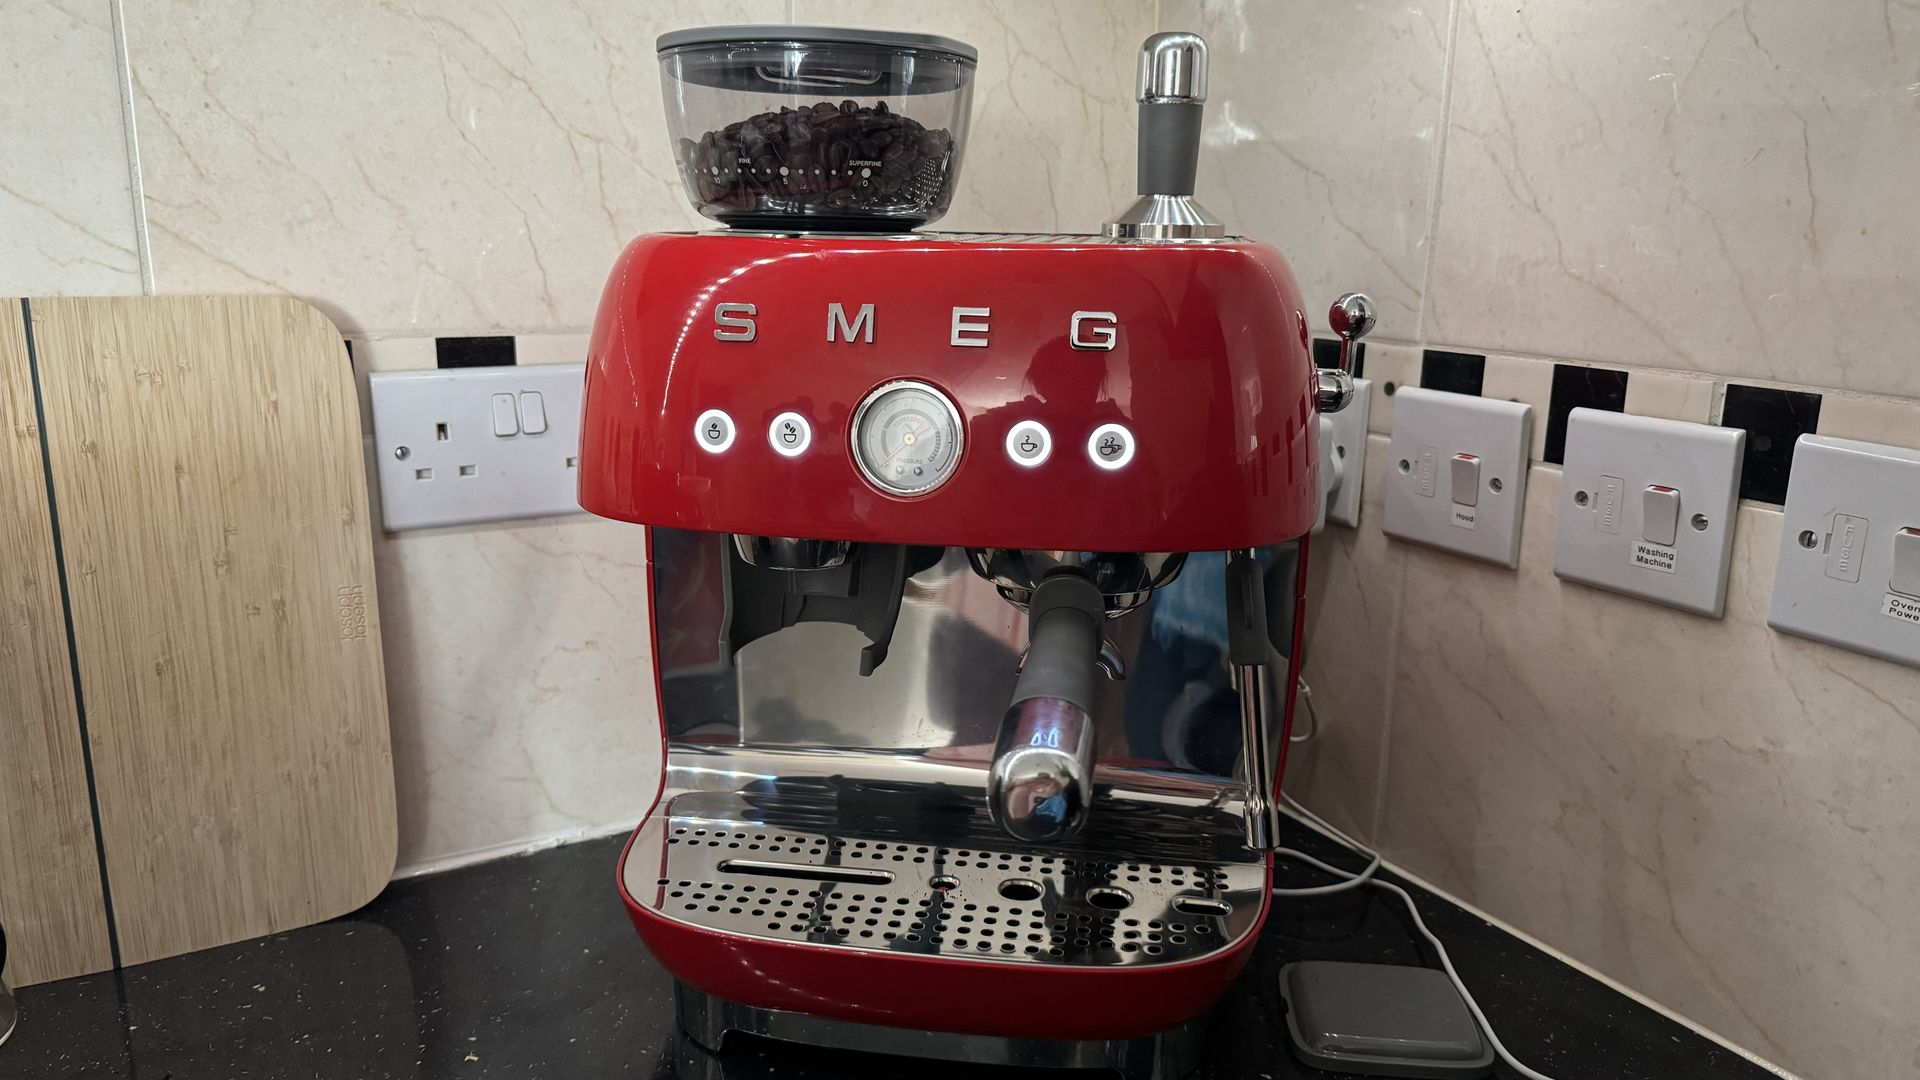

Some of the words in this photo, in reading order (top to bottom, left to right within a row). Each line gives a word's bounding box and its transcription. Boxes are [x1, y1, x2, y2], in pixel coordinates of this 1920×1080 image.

[782, 177, 789, 185] 5
[713, 302, 1119, 351] SMEG
[1455, 511, 1474, 523] Hood
[1637, 545, 1674, 560] Washing
[1839, 524, 1854, 572] FUSE
[1636, 554, 1672, 570] Machine
[1891, 600, 1920, 612] Oven
[1888, 608, 1920, 621] Powe
